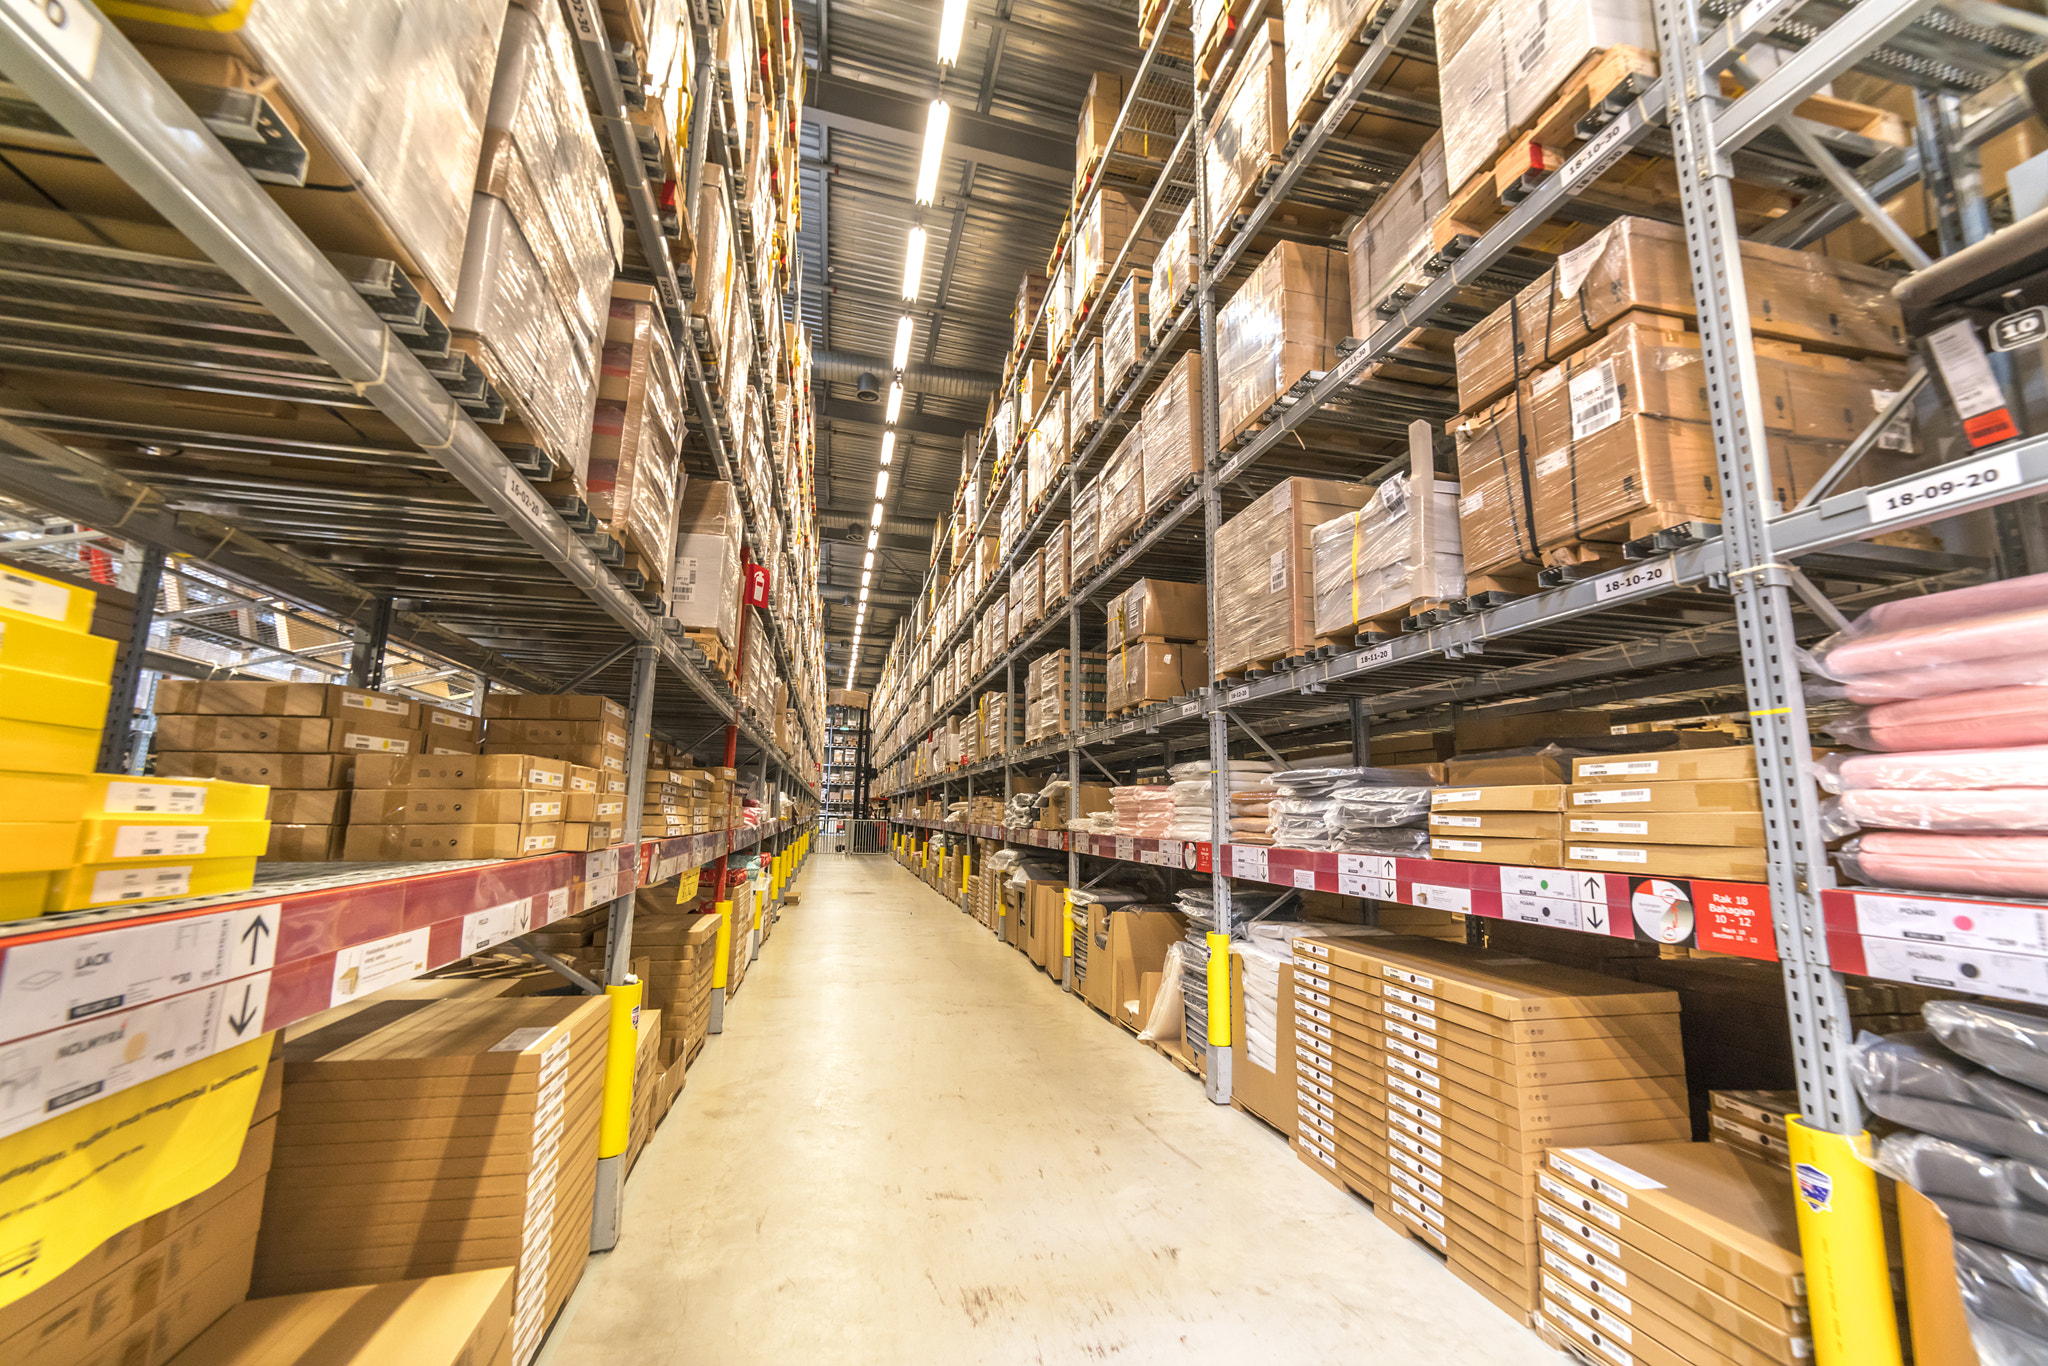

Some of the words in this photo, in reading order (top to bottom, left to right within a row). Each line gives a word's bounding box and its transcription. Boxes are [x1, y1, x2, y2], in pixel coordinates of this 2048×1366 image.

[1568, 125, 1620, 175] 18-10-30
[1575, 150, 1623, 190] 18-10-30
[1341, 347, 1366, 372] 18-11-30
[511, 480, 540, 517] 16-02-20
[1887, 467, 2000, 511] 18-09-20
[1604, 567, 1664, 594] 18-10-20
[1360, 650, 1388, 664] 18-11-20
[1708, 903, 1756, 917] Bahagian
[1712, 893, 1733, 904] Rak
[1735, 896, 1749, 906] 18
[1715, 914, 1728, 924] 10
[1738, 917, 1752, 927] 12
[74, 951, 112, 970] LACK
